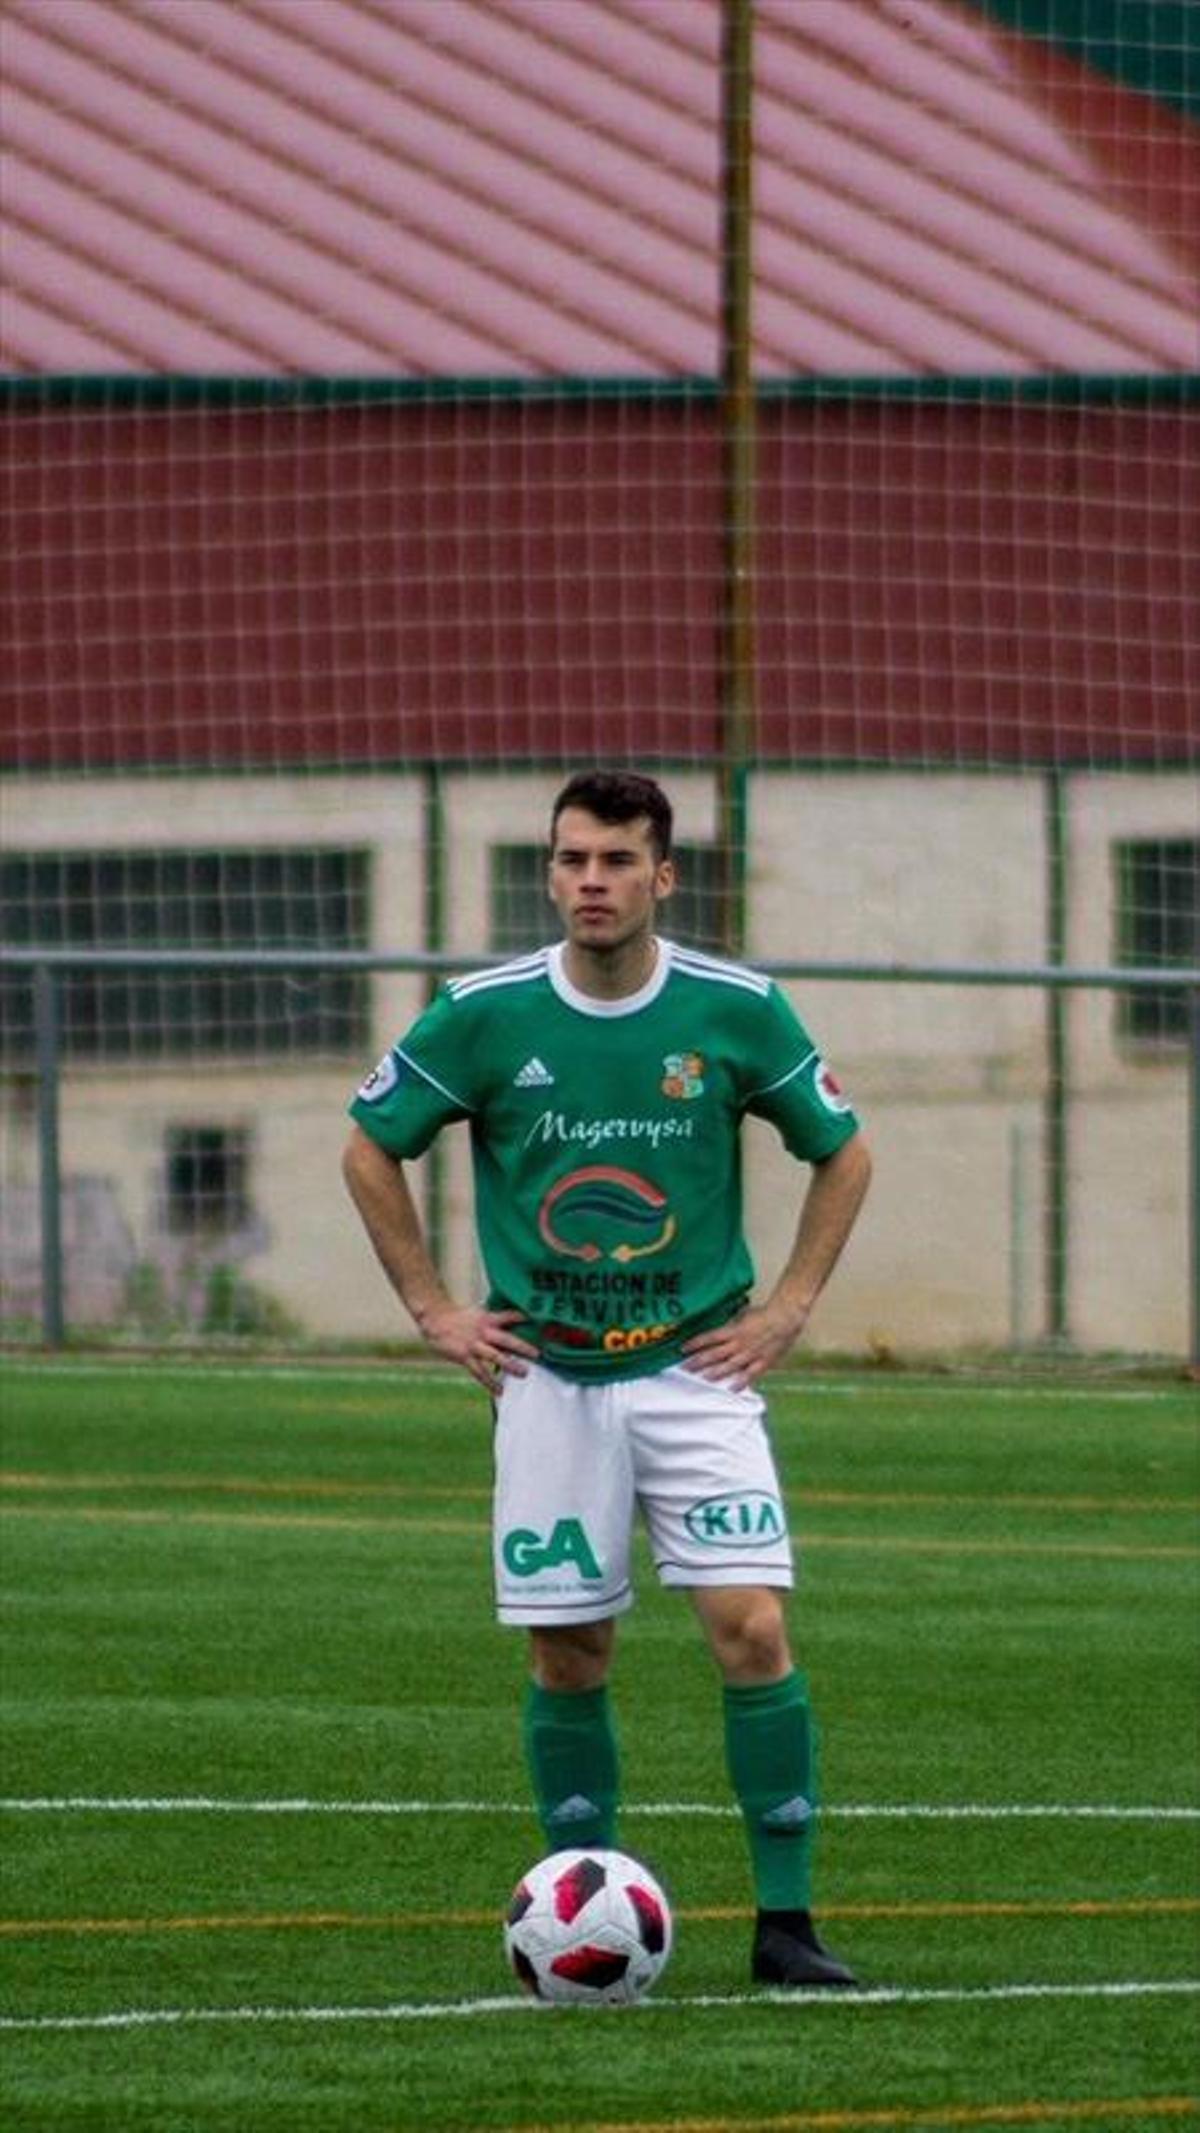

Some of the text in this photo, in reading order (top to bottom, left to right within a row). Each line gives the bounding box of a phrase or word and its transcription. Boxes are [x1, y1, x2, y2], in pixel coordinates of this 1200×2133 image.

[524, 1110, 694, 1149] Magervysa
[653, 1271, 683, 1294] DE
[529, 1295, 684, 1323] SERVICIO
[704, 1503, 780, 1536] KIA
[502, 1518, 602, 1578] GA
